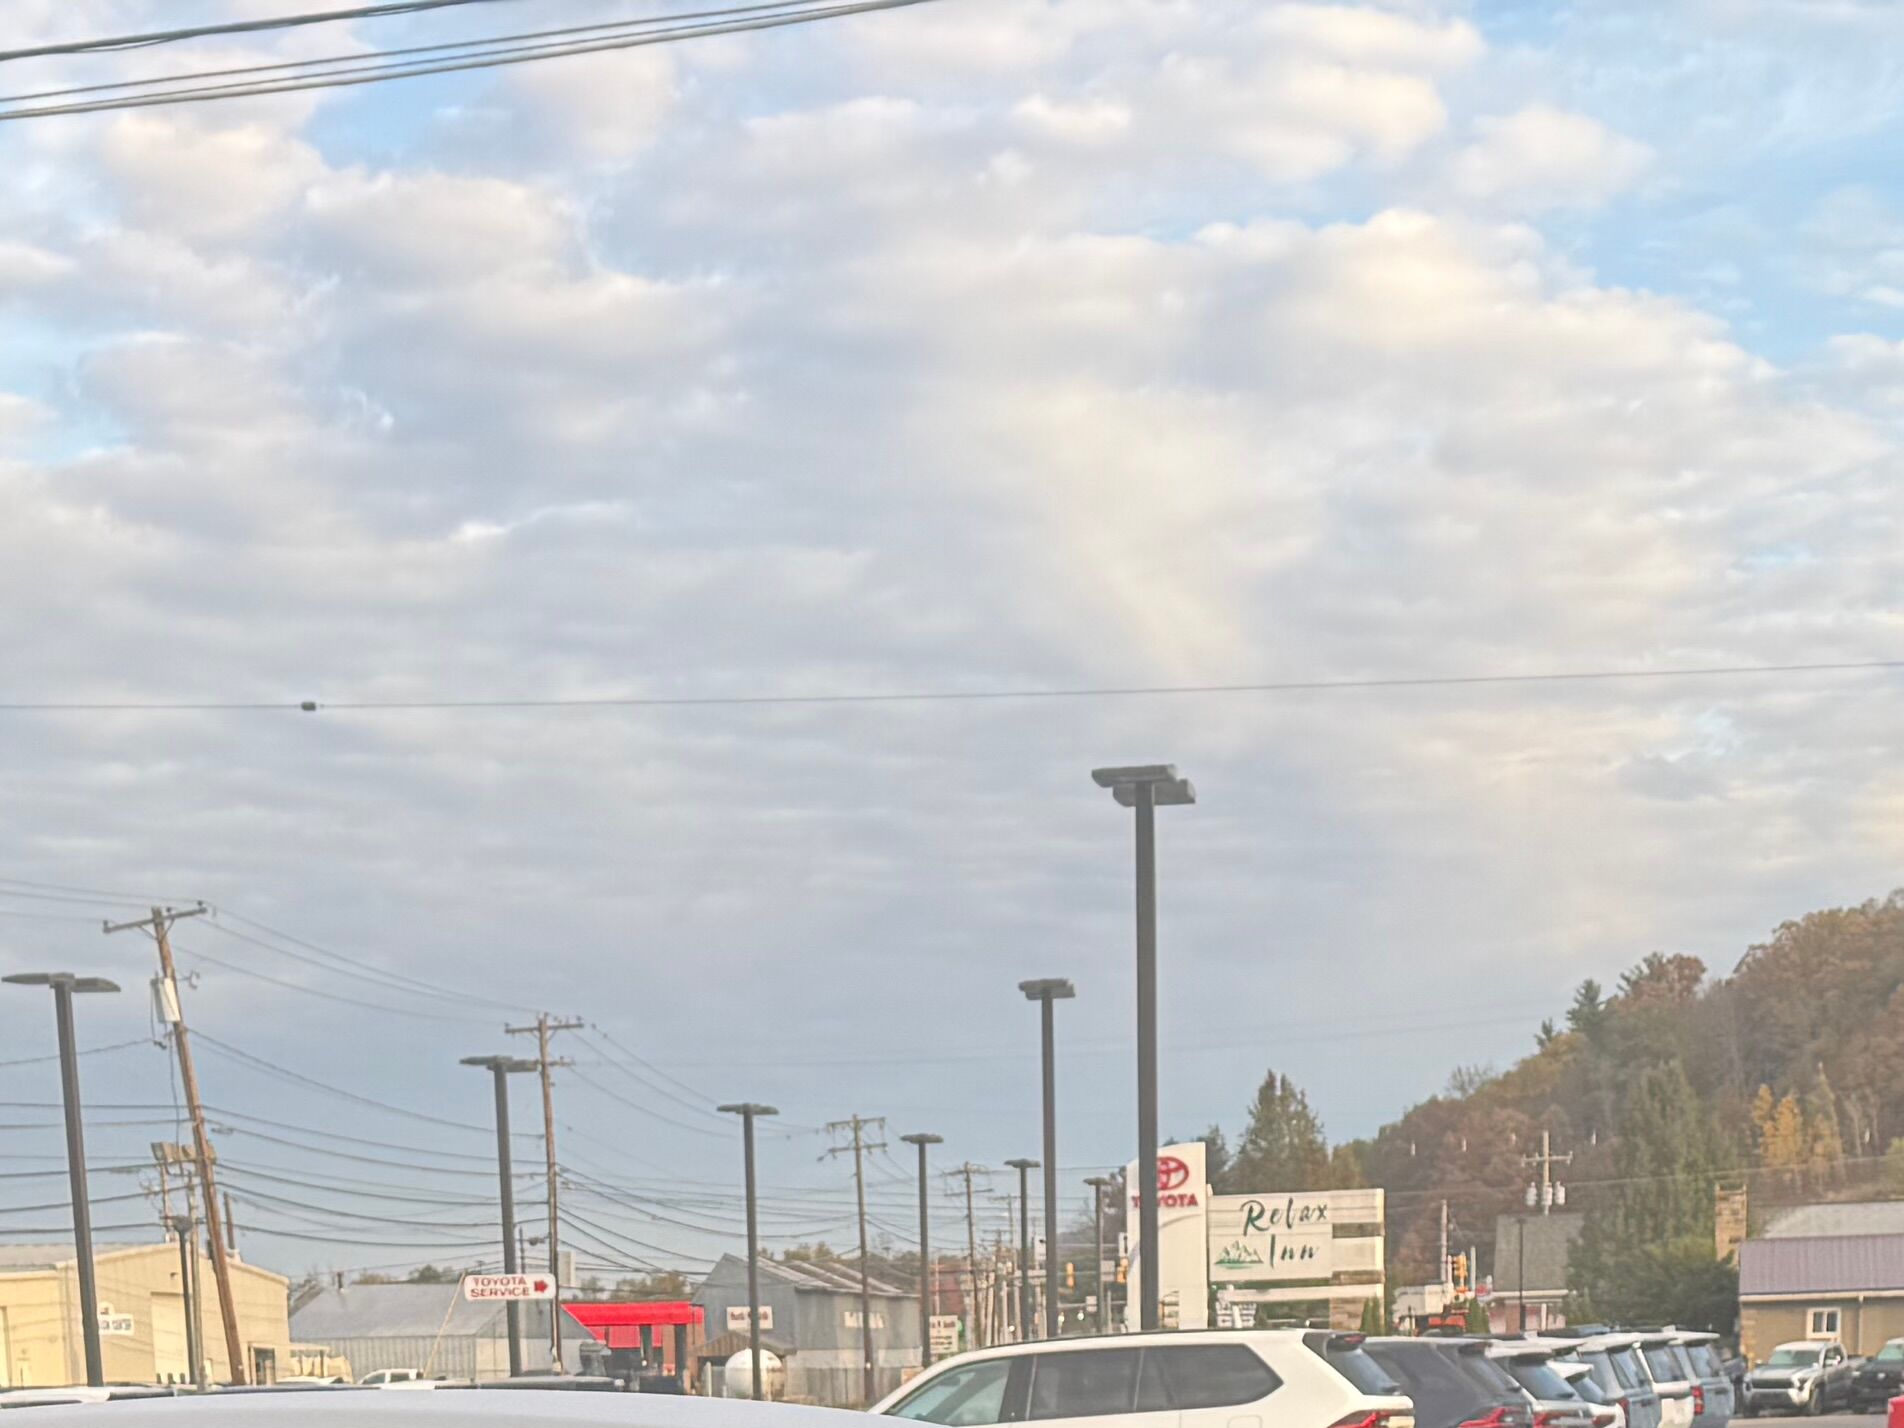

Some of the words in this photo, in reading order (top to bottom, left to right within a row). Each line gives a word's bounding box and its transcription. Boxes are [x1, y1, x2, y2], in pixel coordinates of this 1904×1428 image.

[1130, 1193, 1199, 1208] TYOTA
[1240, 1197, 1328, 1236] Relax
[1269, 1234, 1320, 1268] Inn
[473, 1276, 527, 1287] TOYOTA
[470, 1287, 530, 1297] SERVICE
